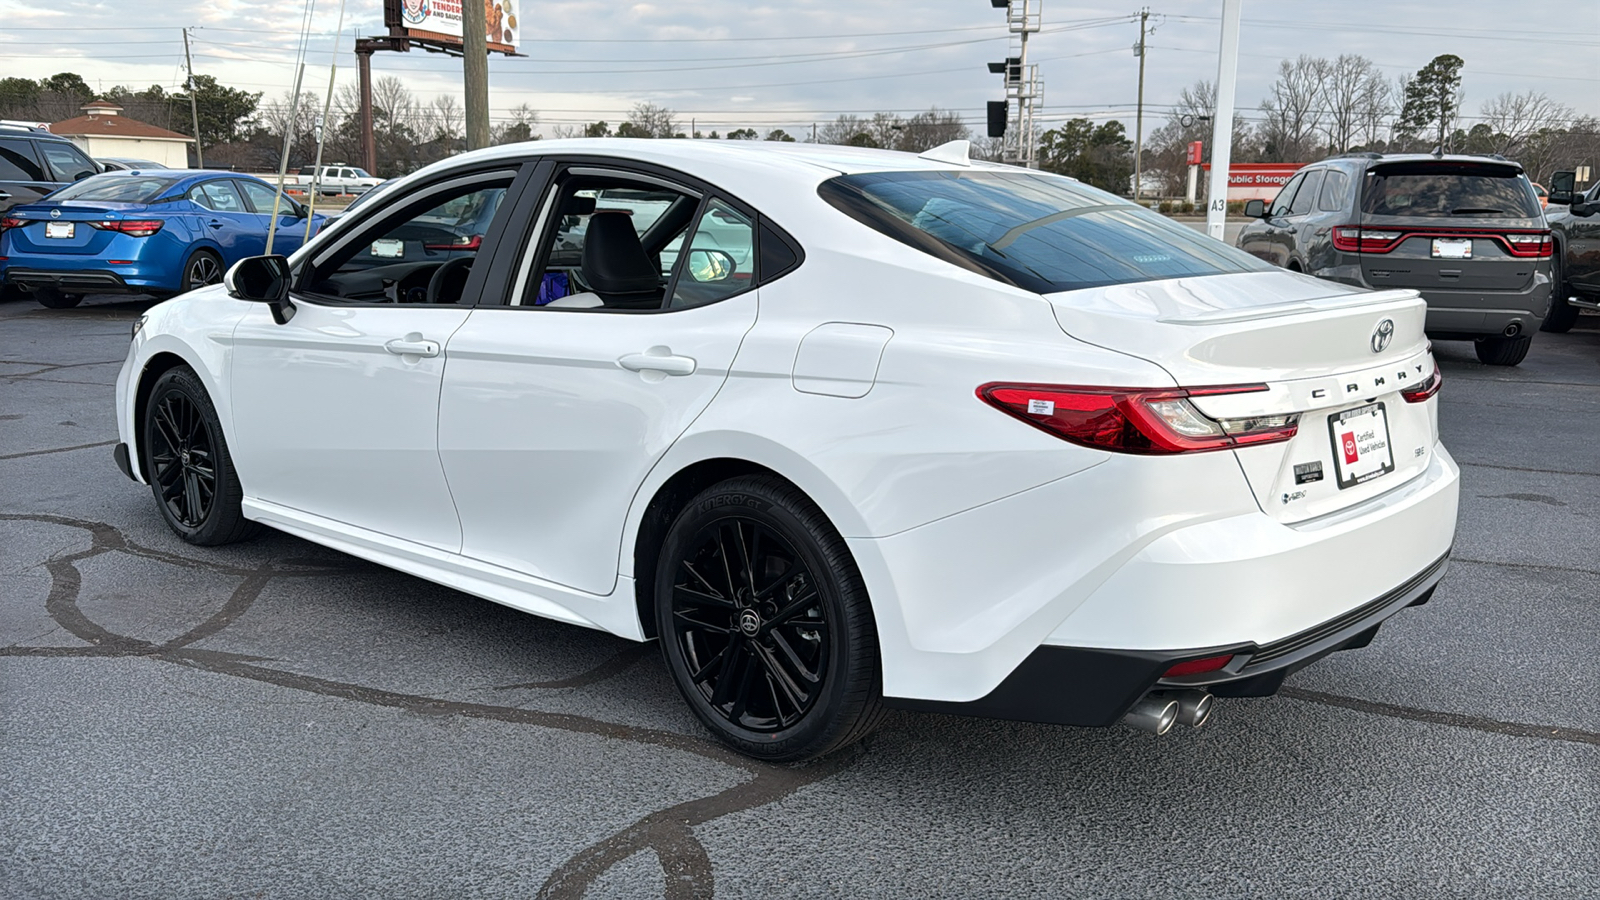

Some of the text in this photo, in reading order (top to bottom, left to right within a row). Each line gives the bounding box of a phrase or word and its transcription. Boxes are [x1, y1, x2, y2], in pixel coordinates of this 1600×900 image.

[433, 10, 444, 18] AND
[1211, 199, 1225, 211] A3
[1311, 364, 1422, 398] CAMRY
[1356, 429, 1375, 443] Certified
[1359, 440, 1386, 455] Used Vehicles
